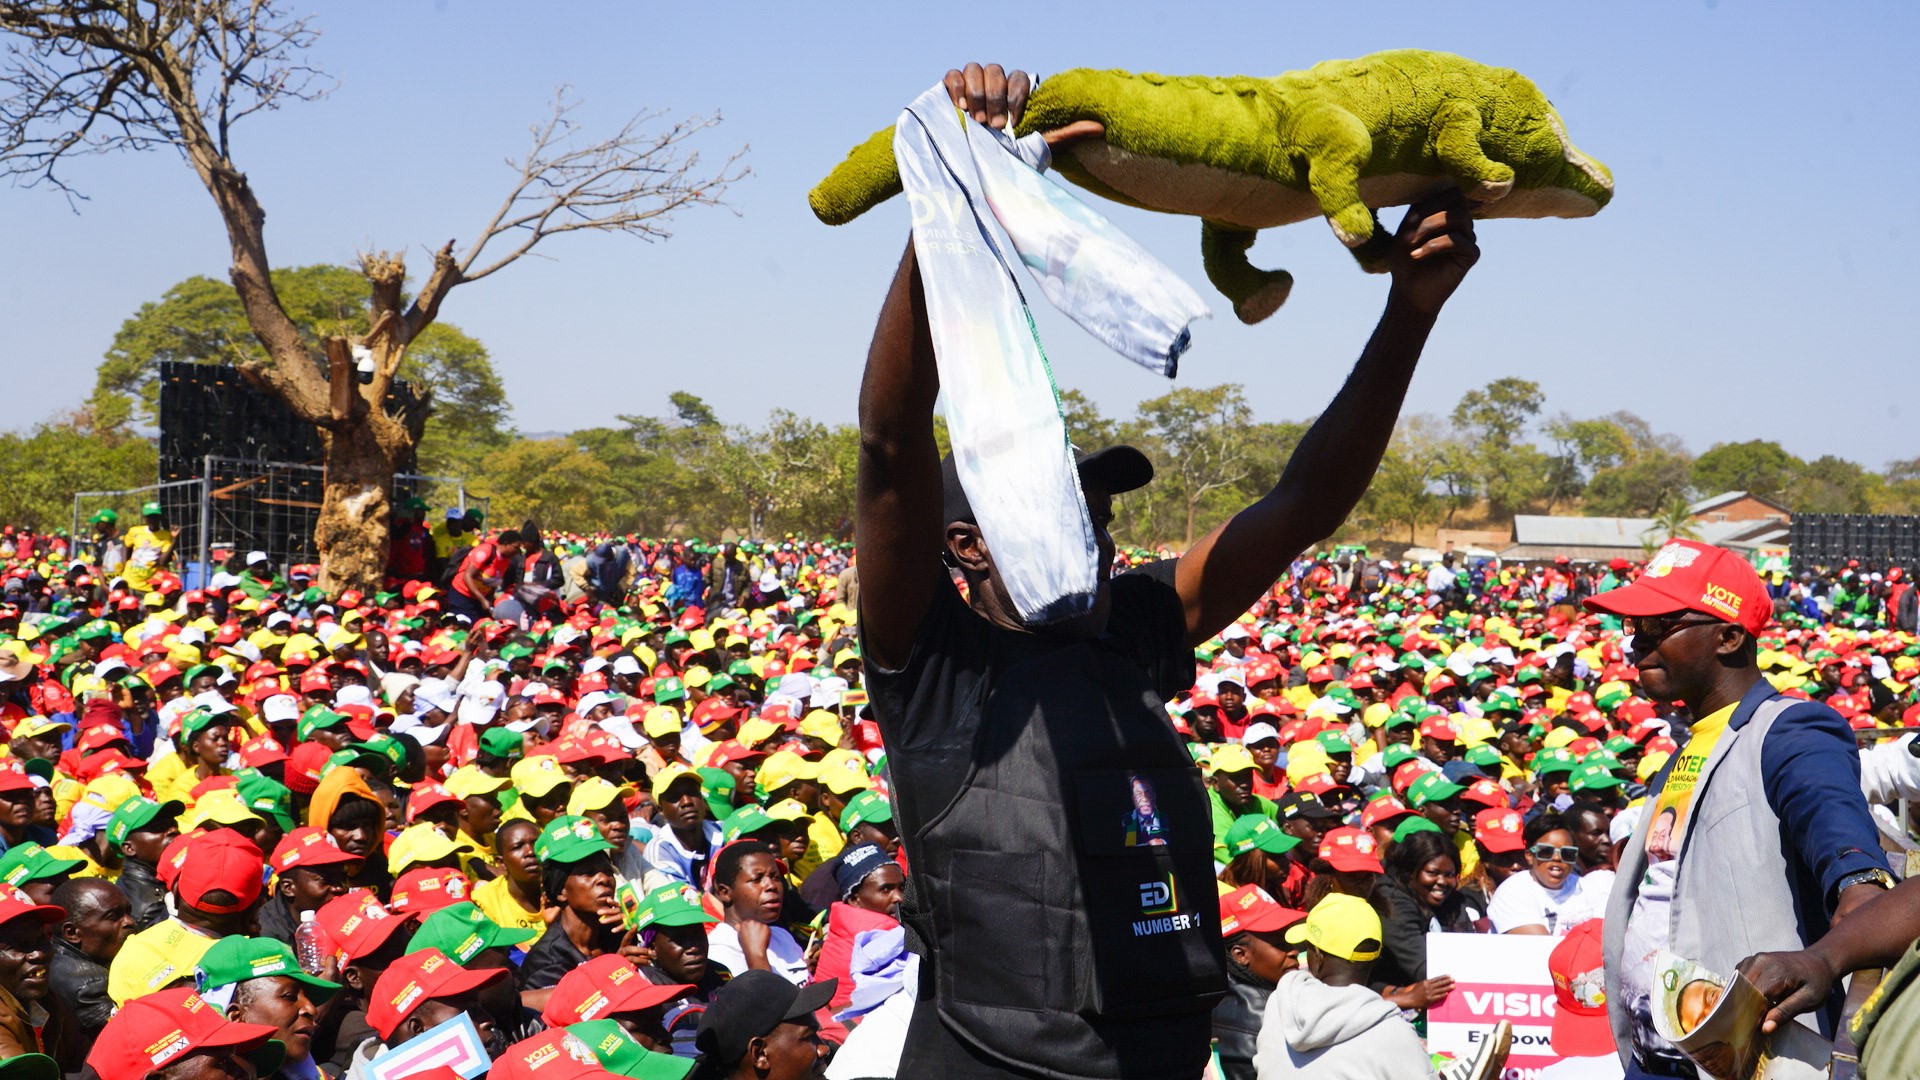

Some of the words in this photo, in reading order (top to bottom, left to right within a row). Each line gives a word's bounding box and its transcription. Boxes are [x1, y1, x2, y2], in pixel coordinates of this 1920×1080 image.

[1706, 582, 1743, 610] VOTE
[418, 878, 439, 887] VOTE
[1140, 881, 1170, 907] ED
[1132, 914, 1191, 937] NUMBER
[1194, 912, 1201, 927] 1
[165, 928, 182, 944] VOTE
[420, 954, 440, 970] VOTE
[608, 966, 630, 981] VOTE
[182, 994, 200, 1009] VOTE
[598, 1033, 618, 1051] VOTE
[523, 1042, 556, 1064] VOTE
